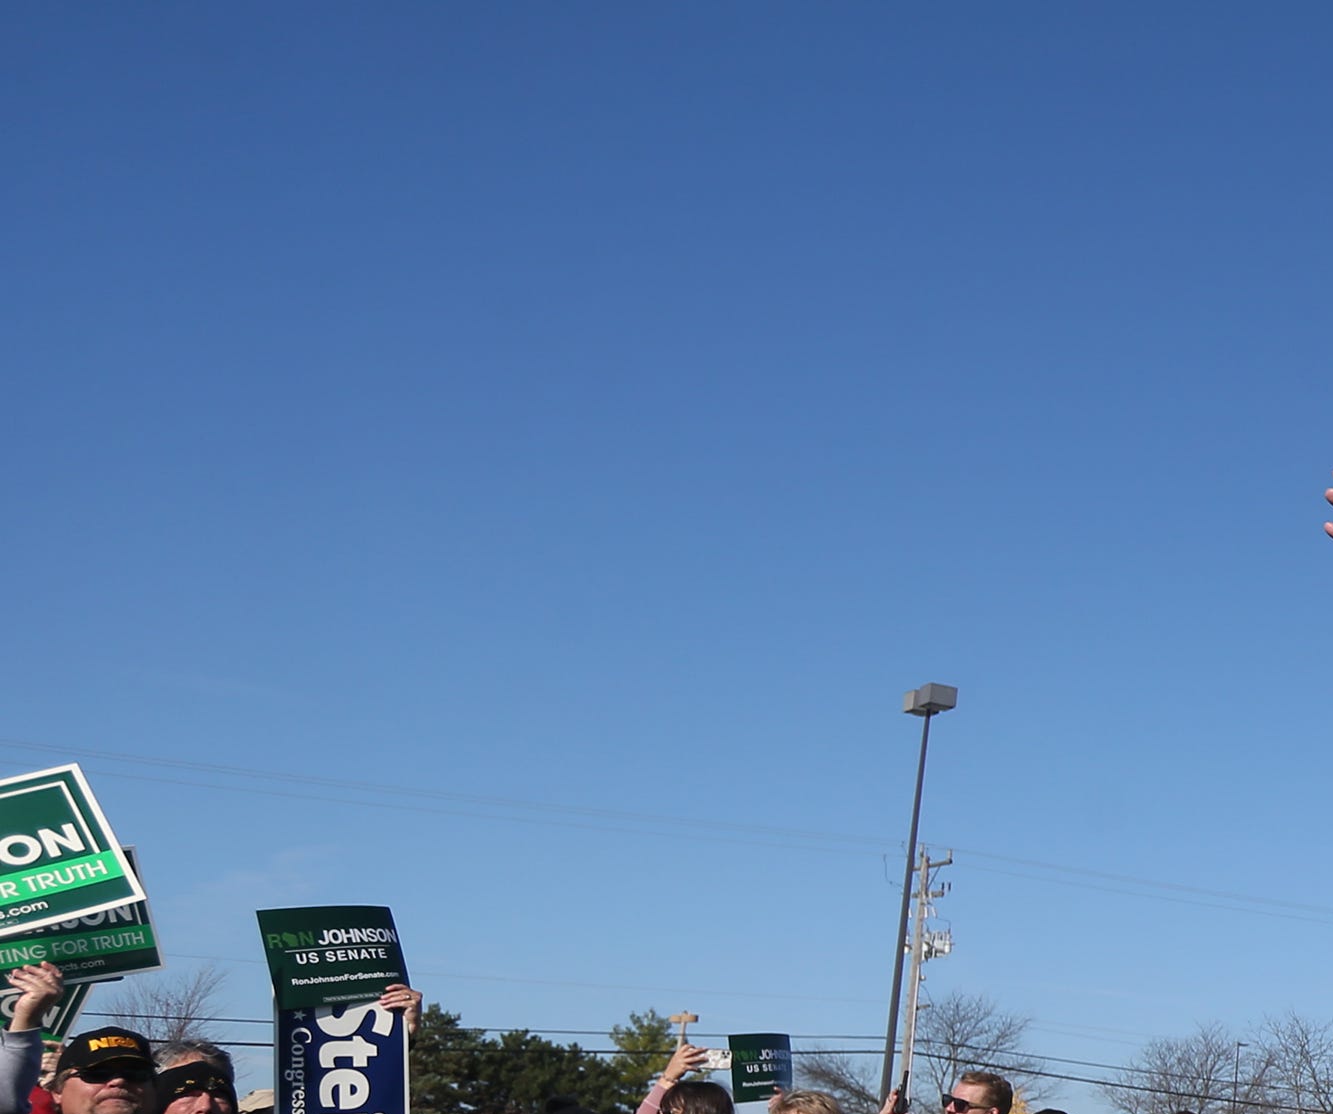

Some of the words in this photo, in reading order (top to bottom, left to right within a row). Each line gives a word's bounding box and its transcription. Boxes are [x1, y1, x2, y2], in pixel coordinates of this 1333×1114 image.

[22, 860, 108, 892] TRUTH
[52, 939, 89, 956] FOR
[91, 931, 145, 950] TRUTH
[318, 928, 398, 945] JOHNSON
[295, 953, 320, 965] US
[325, 948, 388, 962] SENATE
